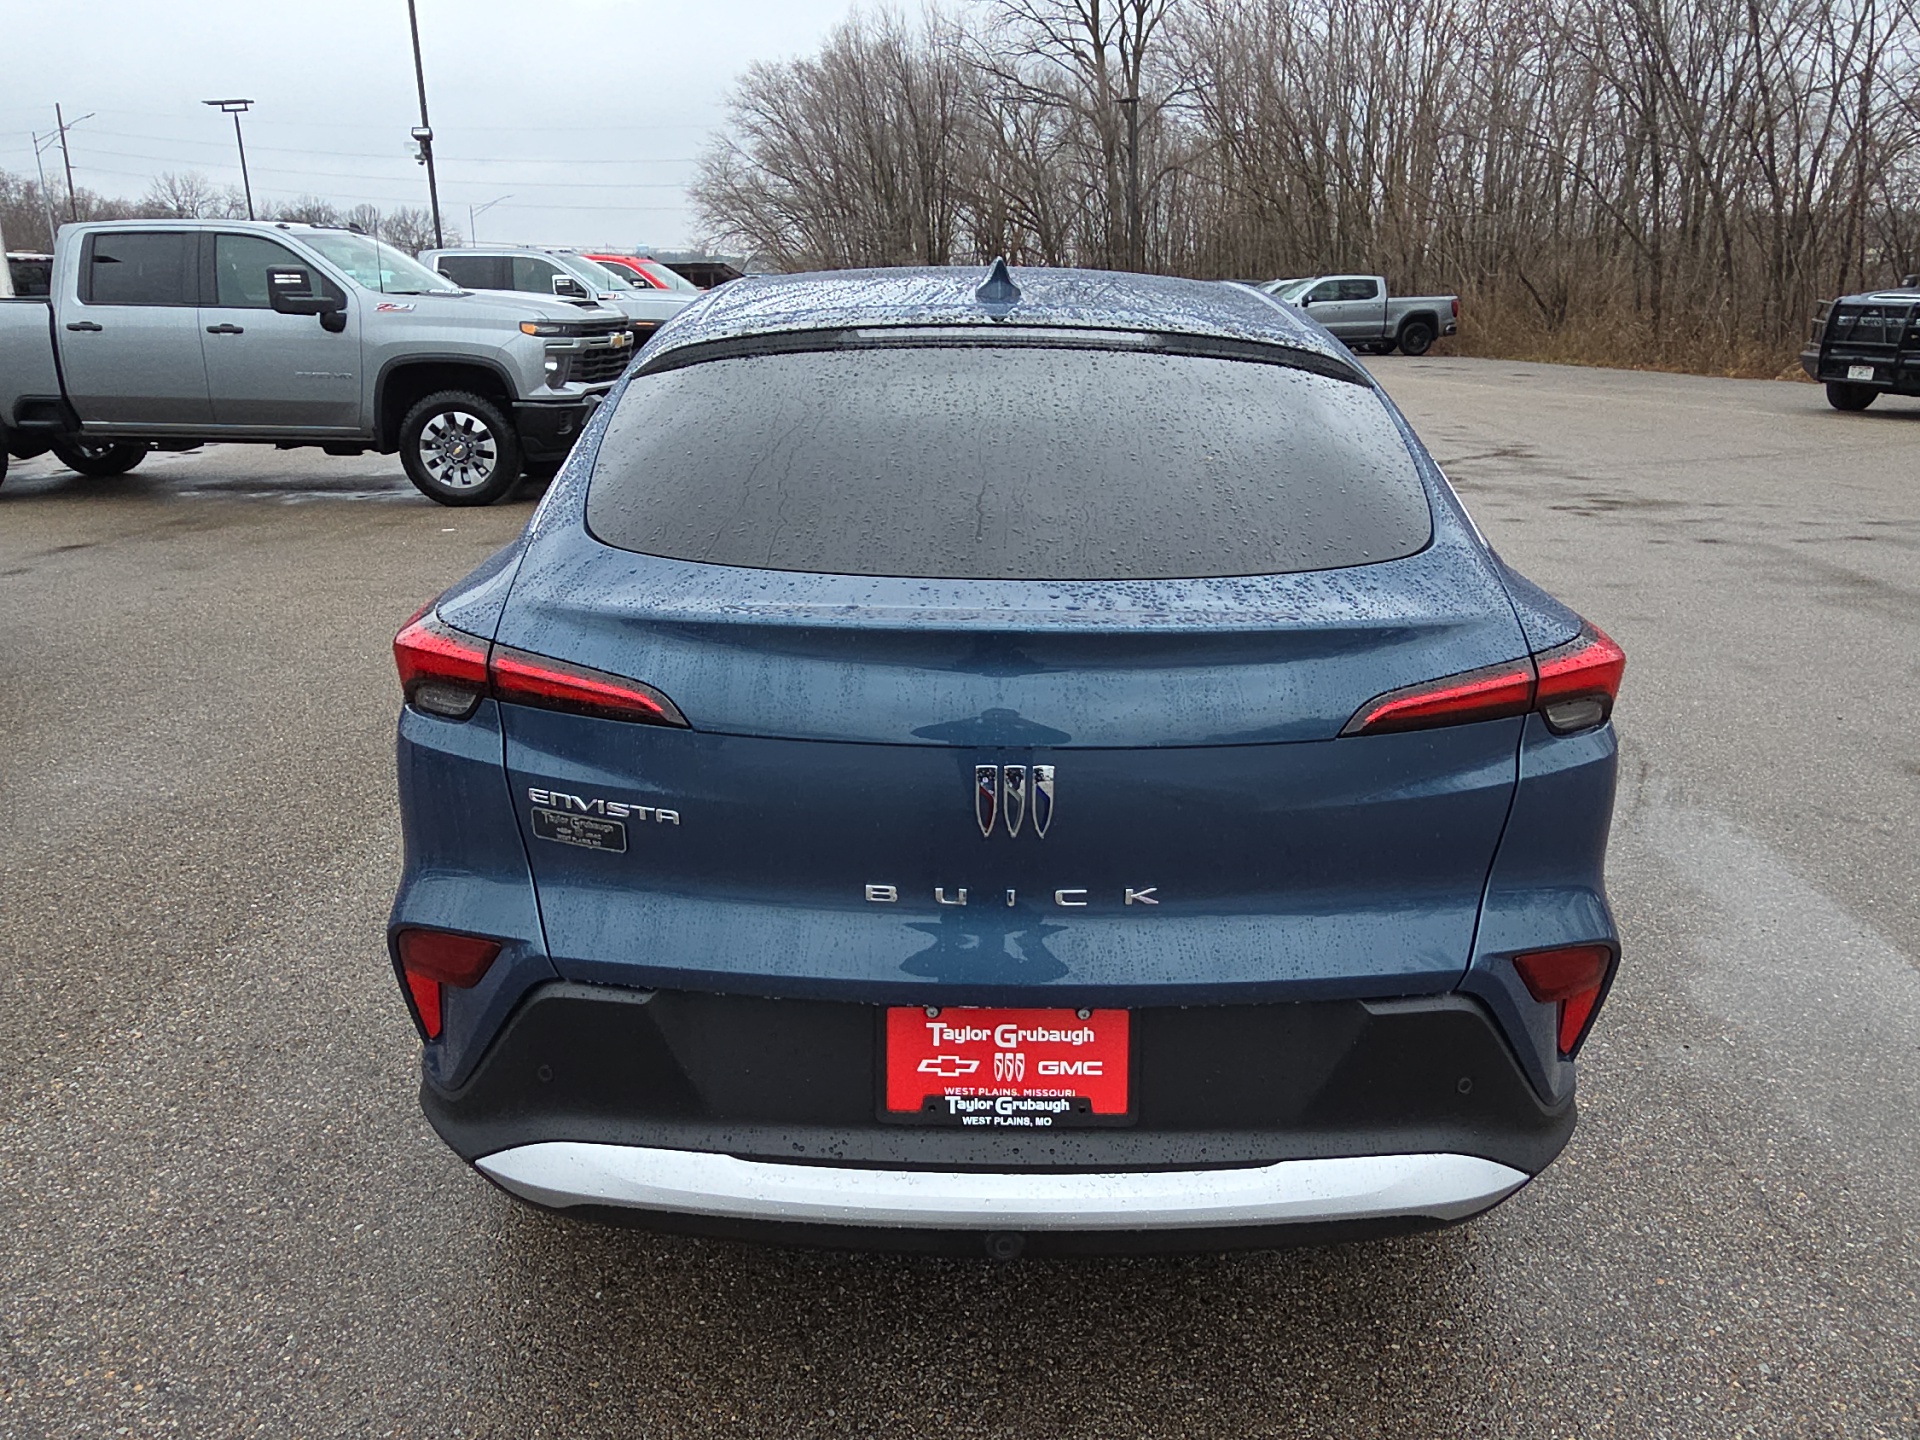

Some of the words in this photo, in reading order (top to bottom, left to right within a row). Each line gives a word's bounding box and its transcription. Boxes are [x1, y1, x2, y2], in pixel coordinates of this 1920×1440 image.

[528, 787, 680, 825] ENVISTA
[865, 884, 1159, 907] BUICK
[926, 1023, 991, 1046] Taylor
[994, 1024, 1095, 1048] Grubaugh
[1038, 1061, 1102, 1075] GMC
[944, 1087, 975, 1096] WEST
[1023, 1089, 1076, 1097] MISSOURI
[945, 1096, 993, 1114] Taylor
[995, 1097, 1070, 1115] Grubaugh
[962, 1117, 992, 1125] WEST
[994, 1117, 1033, 1127] PLAINS,
[1036, 1117, 1052, 1126] MO
